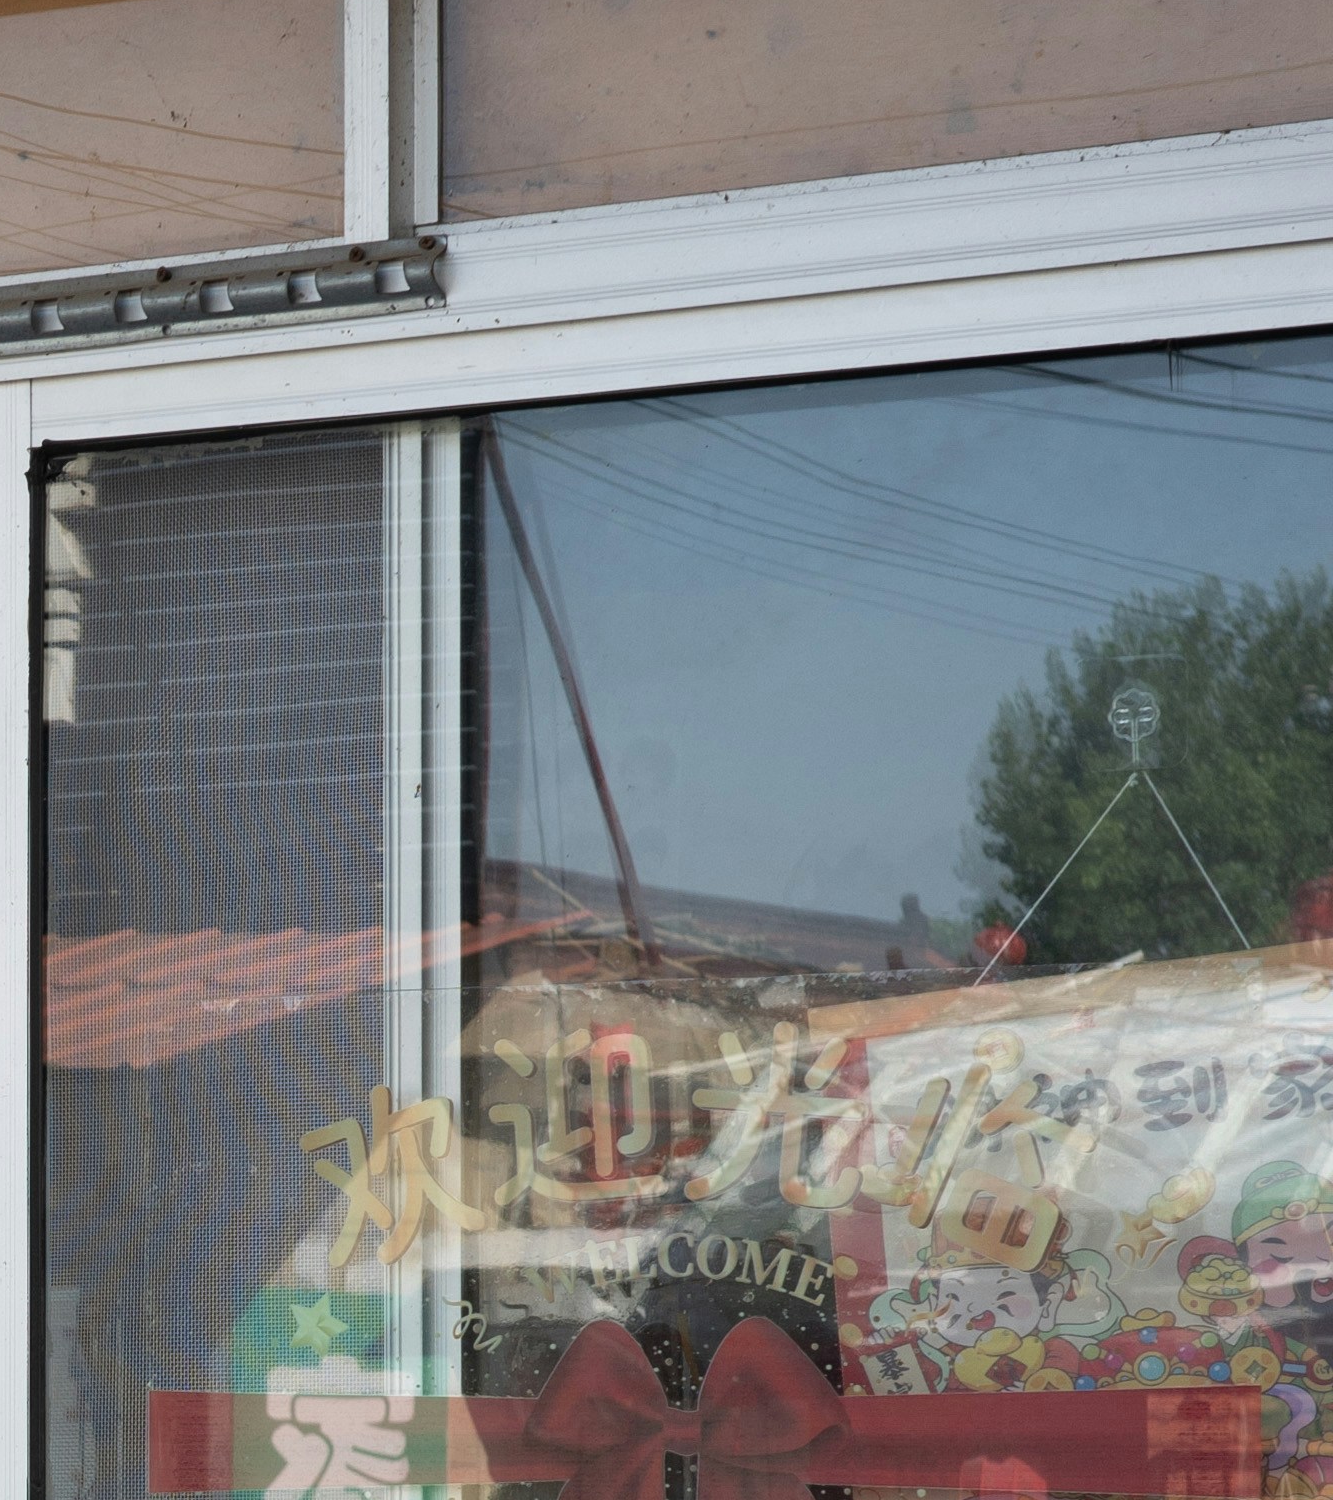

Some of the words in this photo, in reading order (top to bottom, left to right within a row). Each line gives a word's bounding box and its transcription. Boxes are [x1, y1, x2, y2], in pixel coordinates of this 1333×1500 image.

[299, 1021, 1095, 1272] 欢迎光临
[520, 1230, 838, 1306] WELCOME
